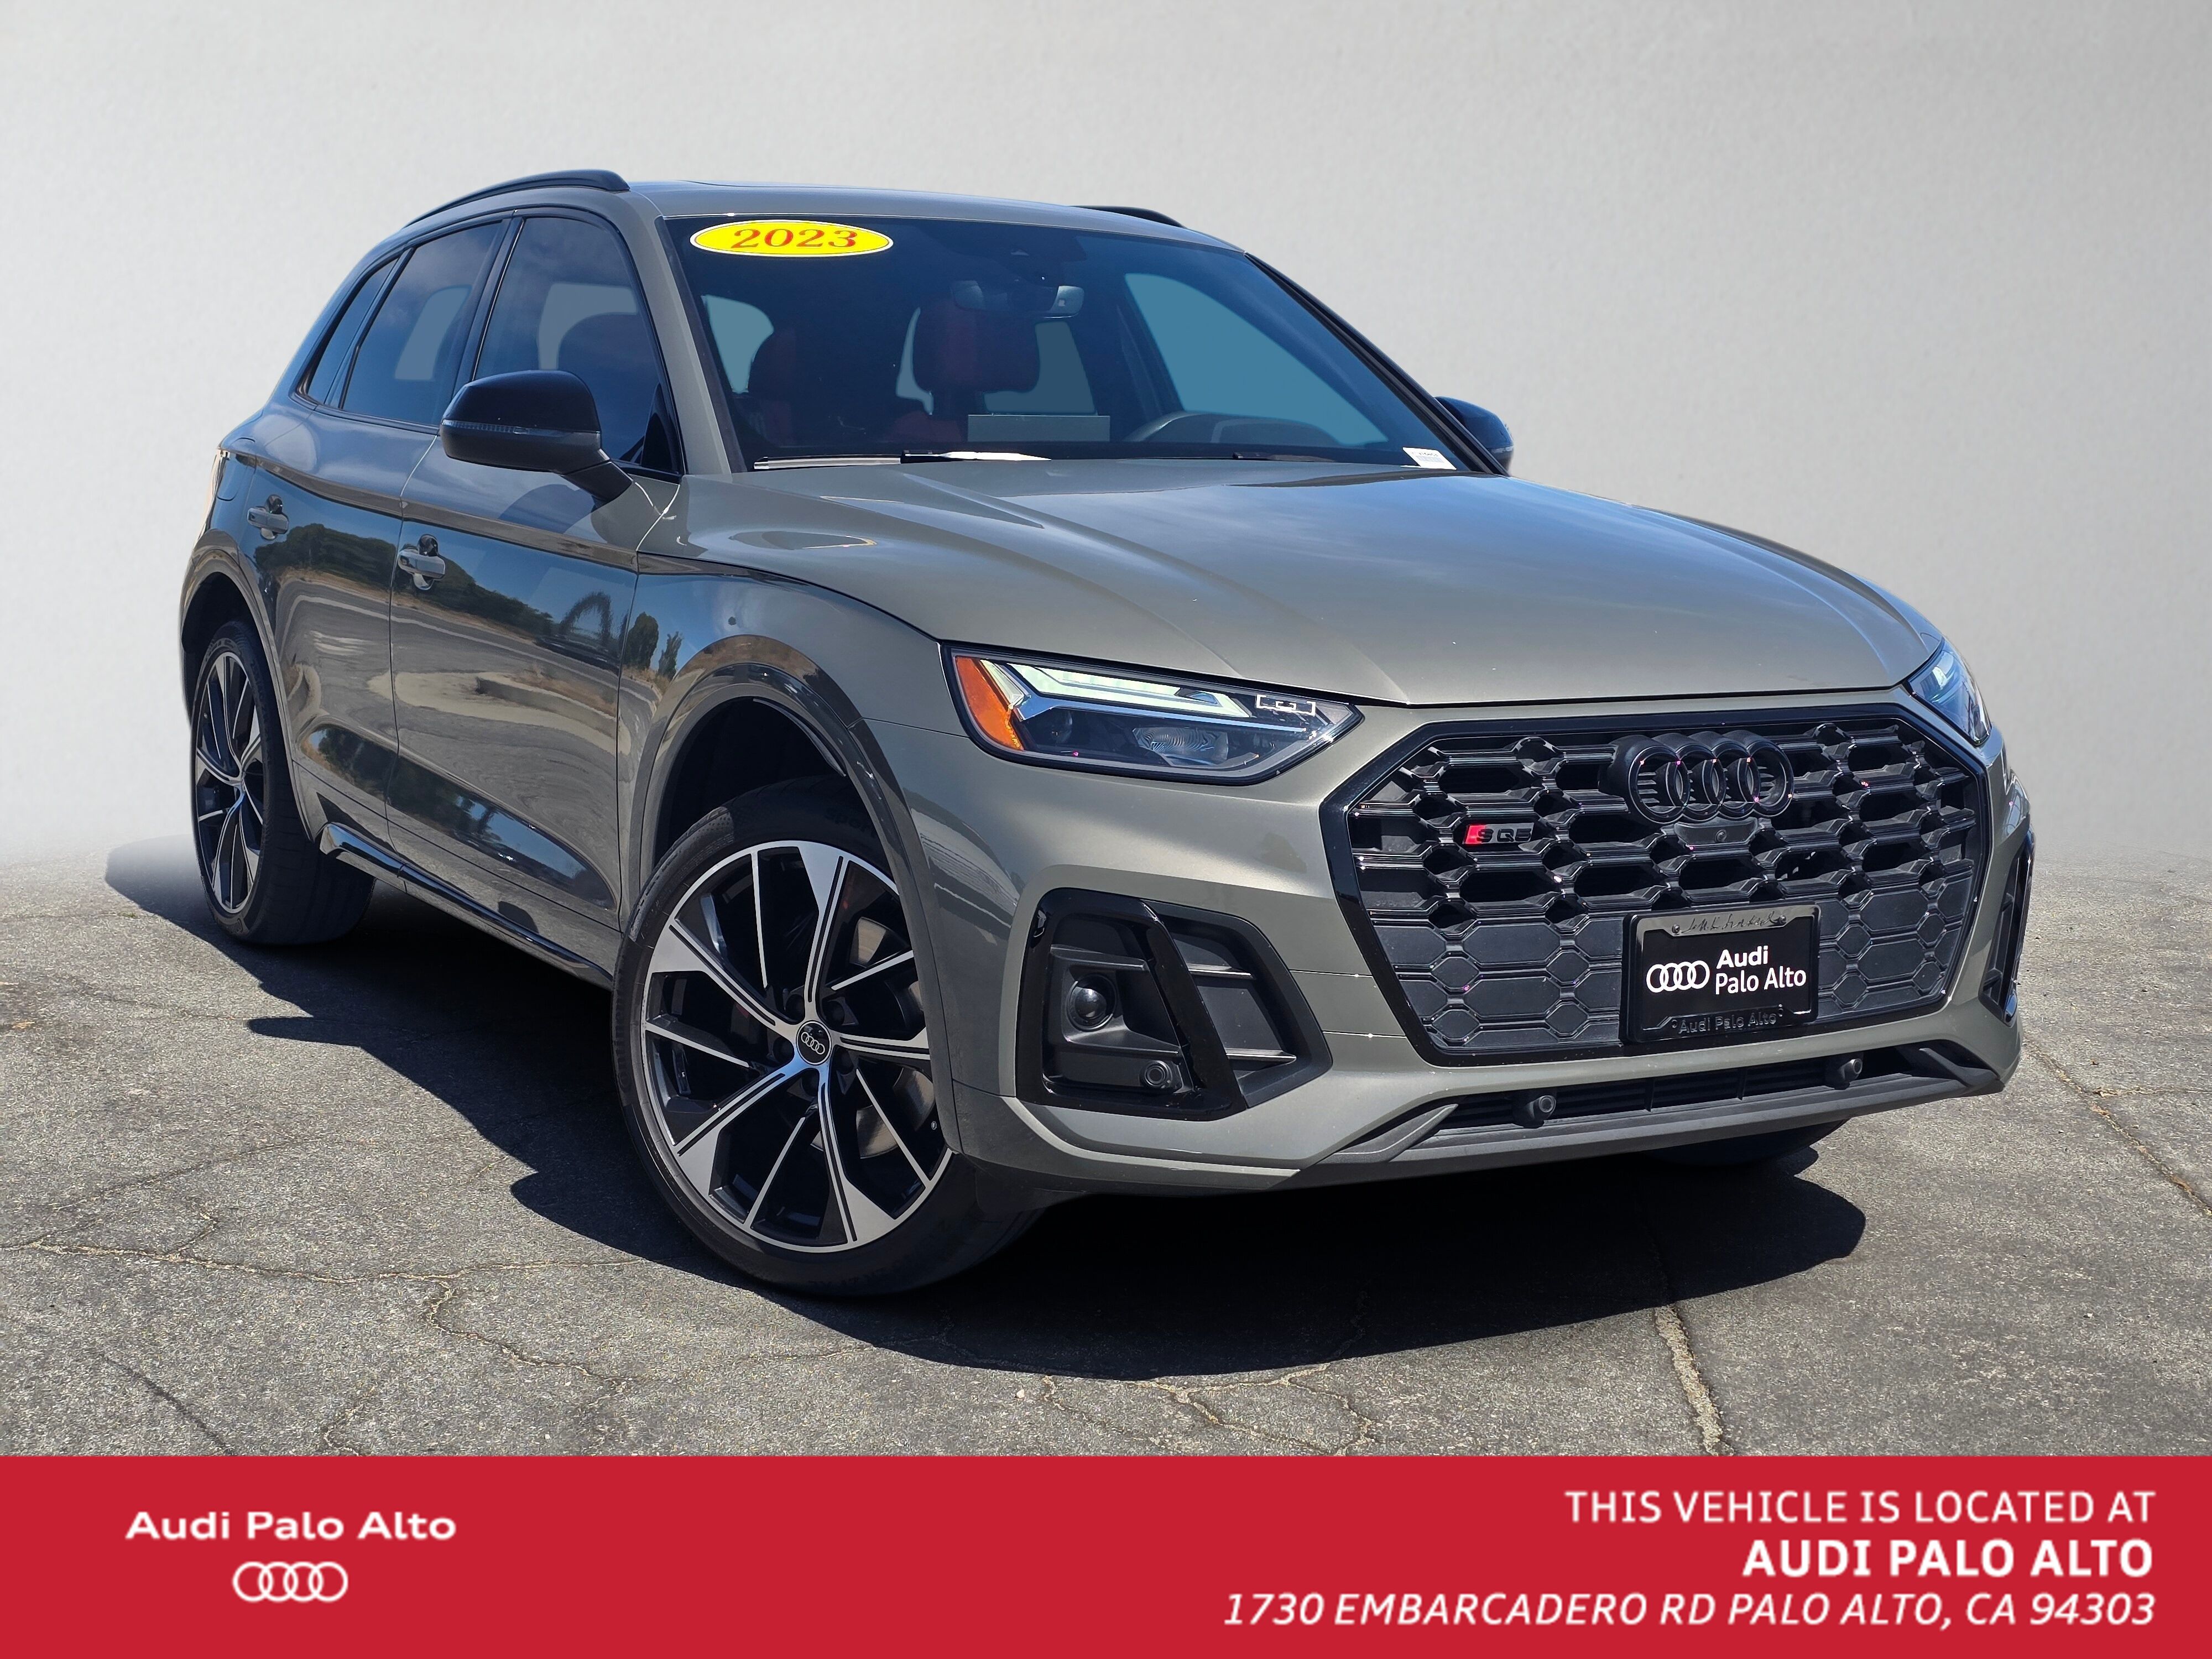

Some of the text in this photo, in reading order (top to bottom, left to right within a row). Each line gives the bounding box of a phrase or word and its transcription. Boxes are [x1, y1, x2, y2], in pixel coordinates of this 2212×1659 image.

[731, 228, 858, 249] 2023
[1716, 945, 1768, 969] Audi
[1715, 966, 1807, 995] Palo Alto
[1678, 1016, 1711, 1034] Audi
[1747, 1011, 1777, 1027] Alto
